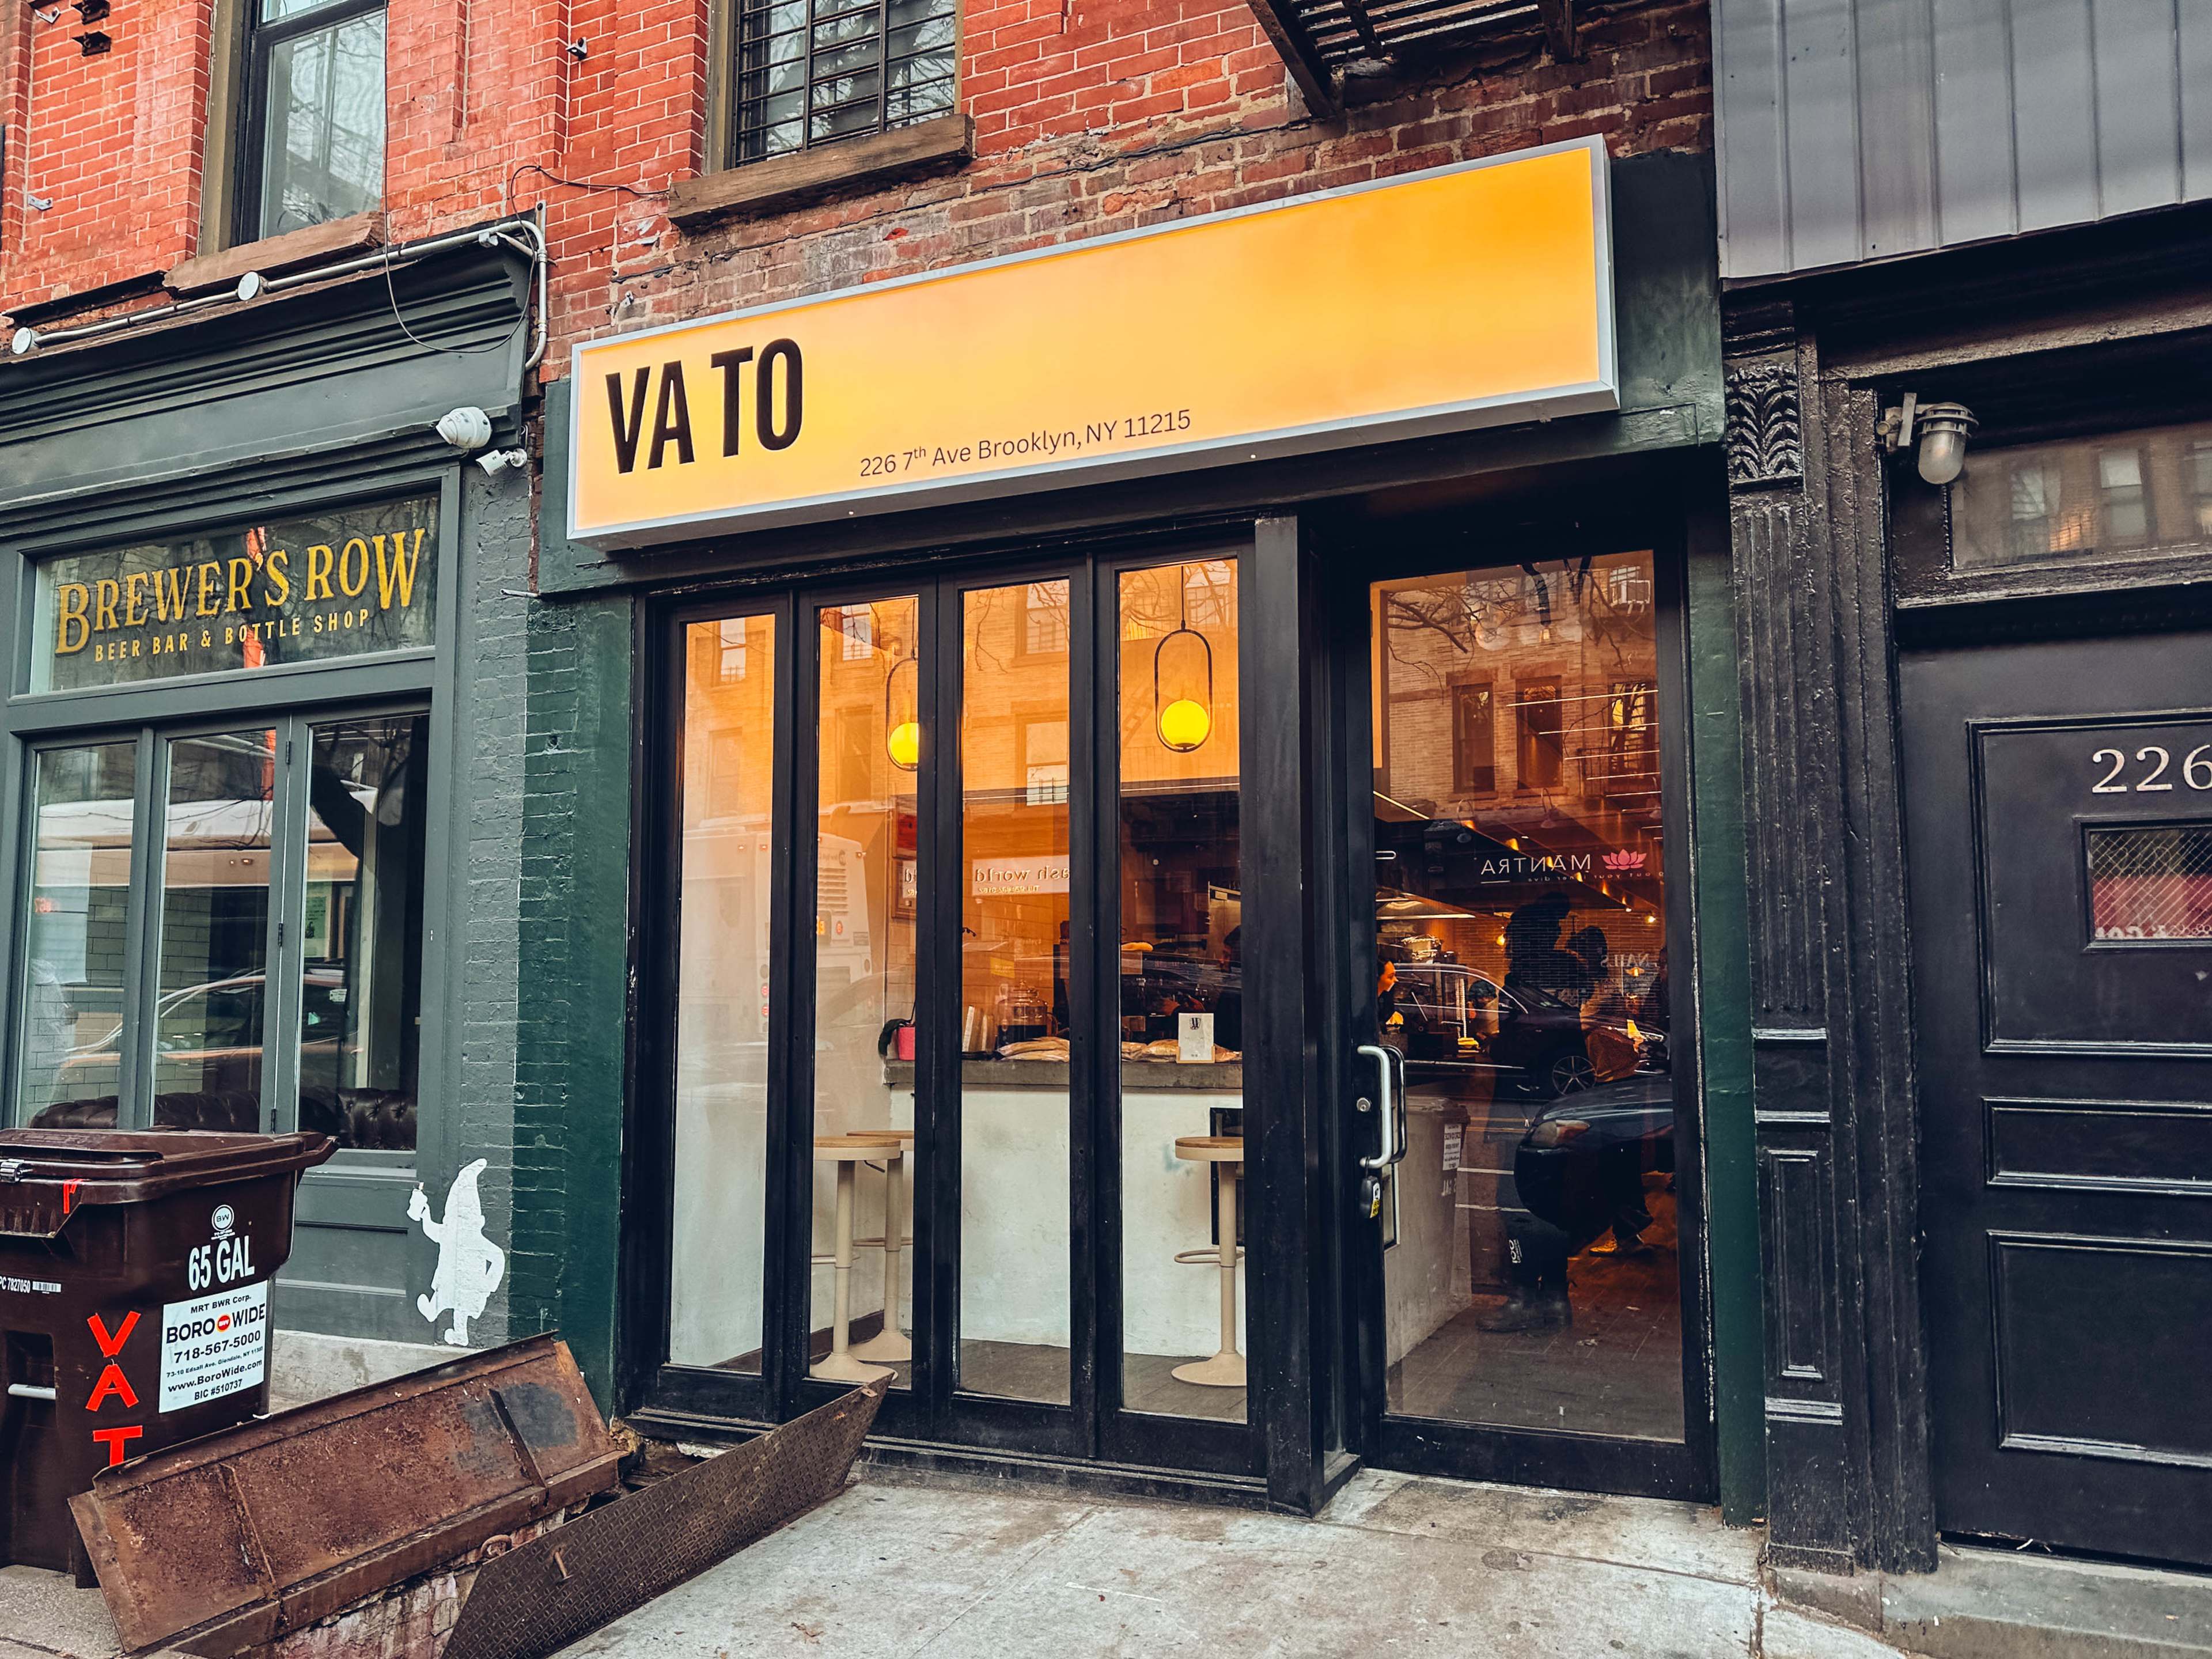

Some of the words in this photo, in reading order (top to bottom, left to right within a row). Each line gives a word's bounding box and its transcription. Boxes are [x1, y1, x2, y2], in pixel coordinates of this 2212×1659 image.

[860, 455, 896, 476] 226
[903, 446, 926, 471] 7th
[933, 447, 971, 466] Ave
[979, 431, 1081, 459] Brooklyn,
[1086, 421, 1118, 444] NY
[1124, 410, 1191, 438] 11215
[55, 550, 289, 654] BREWER'S
[304, 528, 425, 609] ROW
[95, 640, 141, 662] BEER
[152, 633, 188, 654] BAR
[201, 630, 211, 647] &
[225, 618, 301, 645] BOTTLE
[313, 608, 369, 633] SHOP
[2092, 744, 2212, 793] 226
[189, 1245, 211, 1291] 65
[216, 1236, 255, 1283] GAL
[7, 1277, 31, 1293] 7827050
[191, 1304, 209, 1313] MRT
[212, 1298, 230, 1309] BWR
[233, 1295, 252, 1303] Corp.
[166, 1318, 215, 1344] BORO
[232, 1303, 266, 1328] WIDE
[174, 1330, 261, 1363] 718-567-5000
[168, 1359, 263, 1392] www.BoroWide.com
[185, 1365, 203, 1373] Edsall
[194, 1389, 209, 1400] BIC
[211, 1379, 243, 1396] #510737
